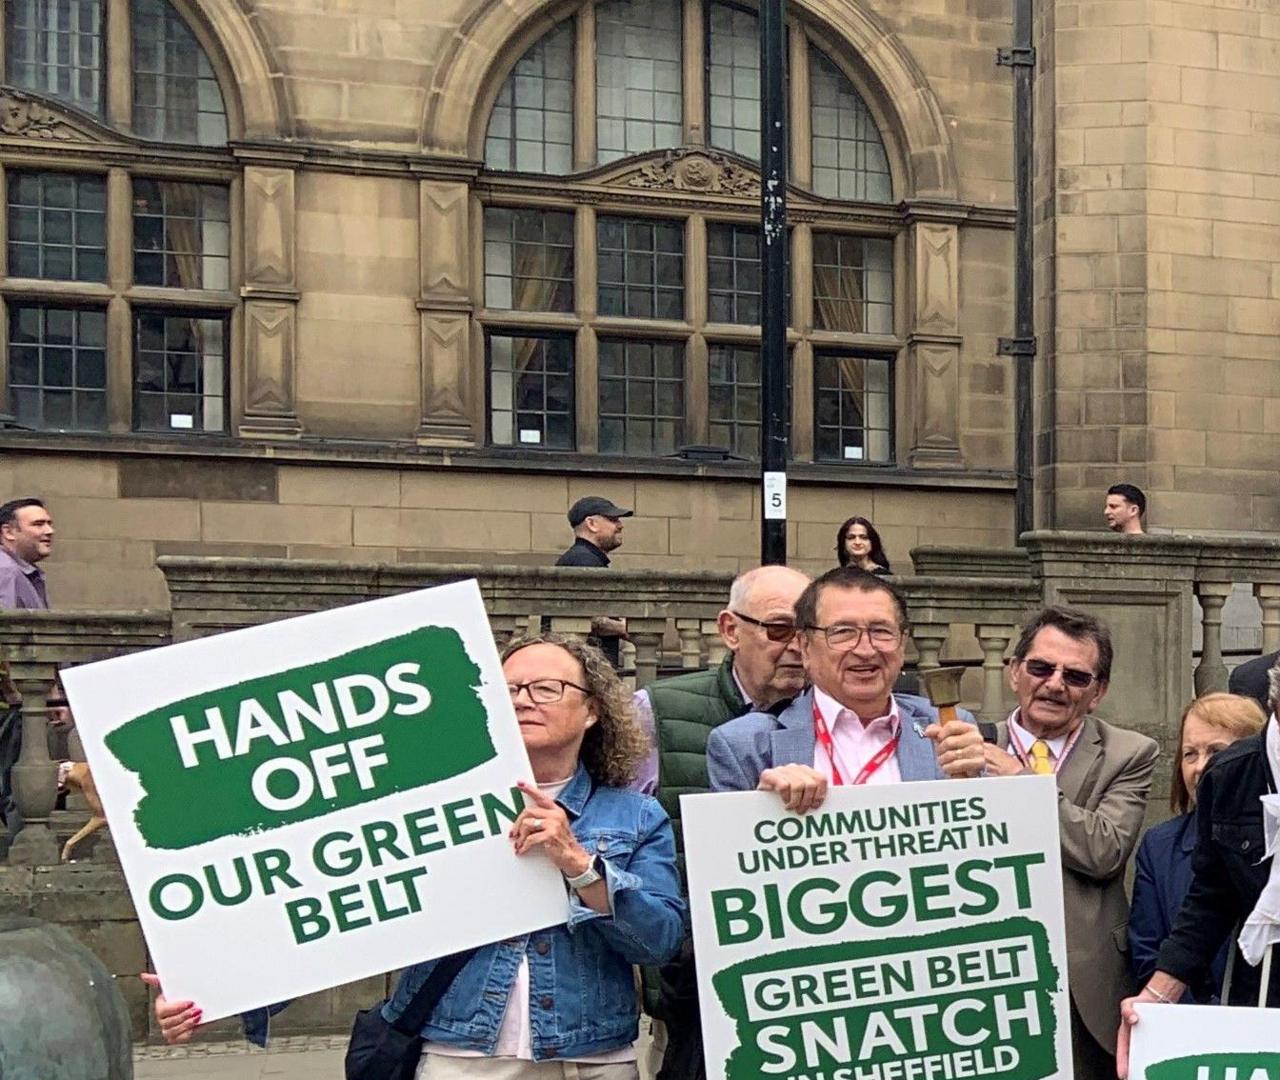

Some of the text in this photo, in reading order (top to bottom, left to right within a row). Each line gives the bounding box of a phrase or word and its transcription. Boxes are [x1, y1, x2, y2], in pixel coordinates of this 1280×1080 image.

[771, 493, 782, 508] 5
[169, 662, 432, 769] HANDS
[250, 734, 389, 812] OFF
[149, 786, 525, 921] OUR GREEN
[737, 822, 1009, 874] UNDER THREAT IN
[753, 797, 987, 844] COMMUNITIES
[285, 866, 428, 945] BELT
[710, 852, 1045, 946] BIGGEST
[754, 944, 1028, 1012] GREEN BELT
[755, 990, 1042, 1074] SNATCH
